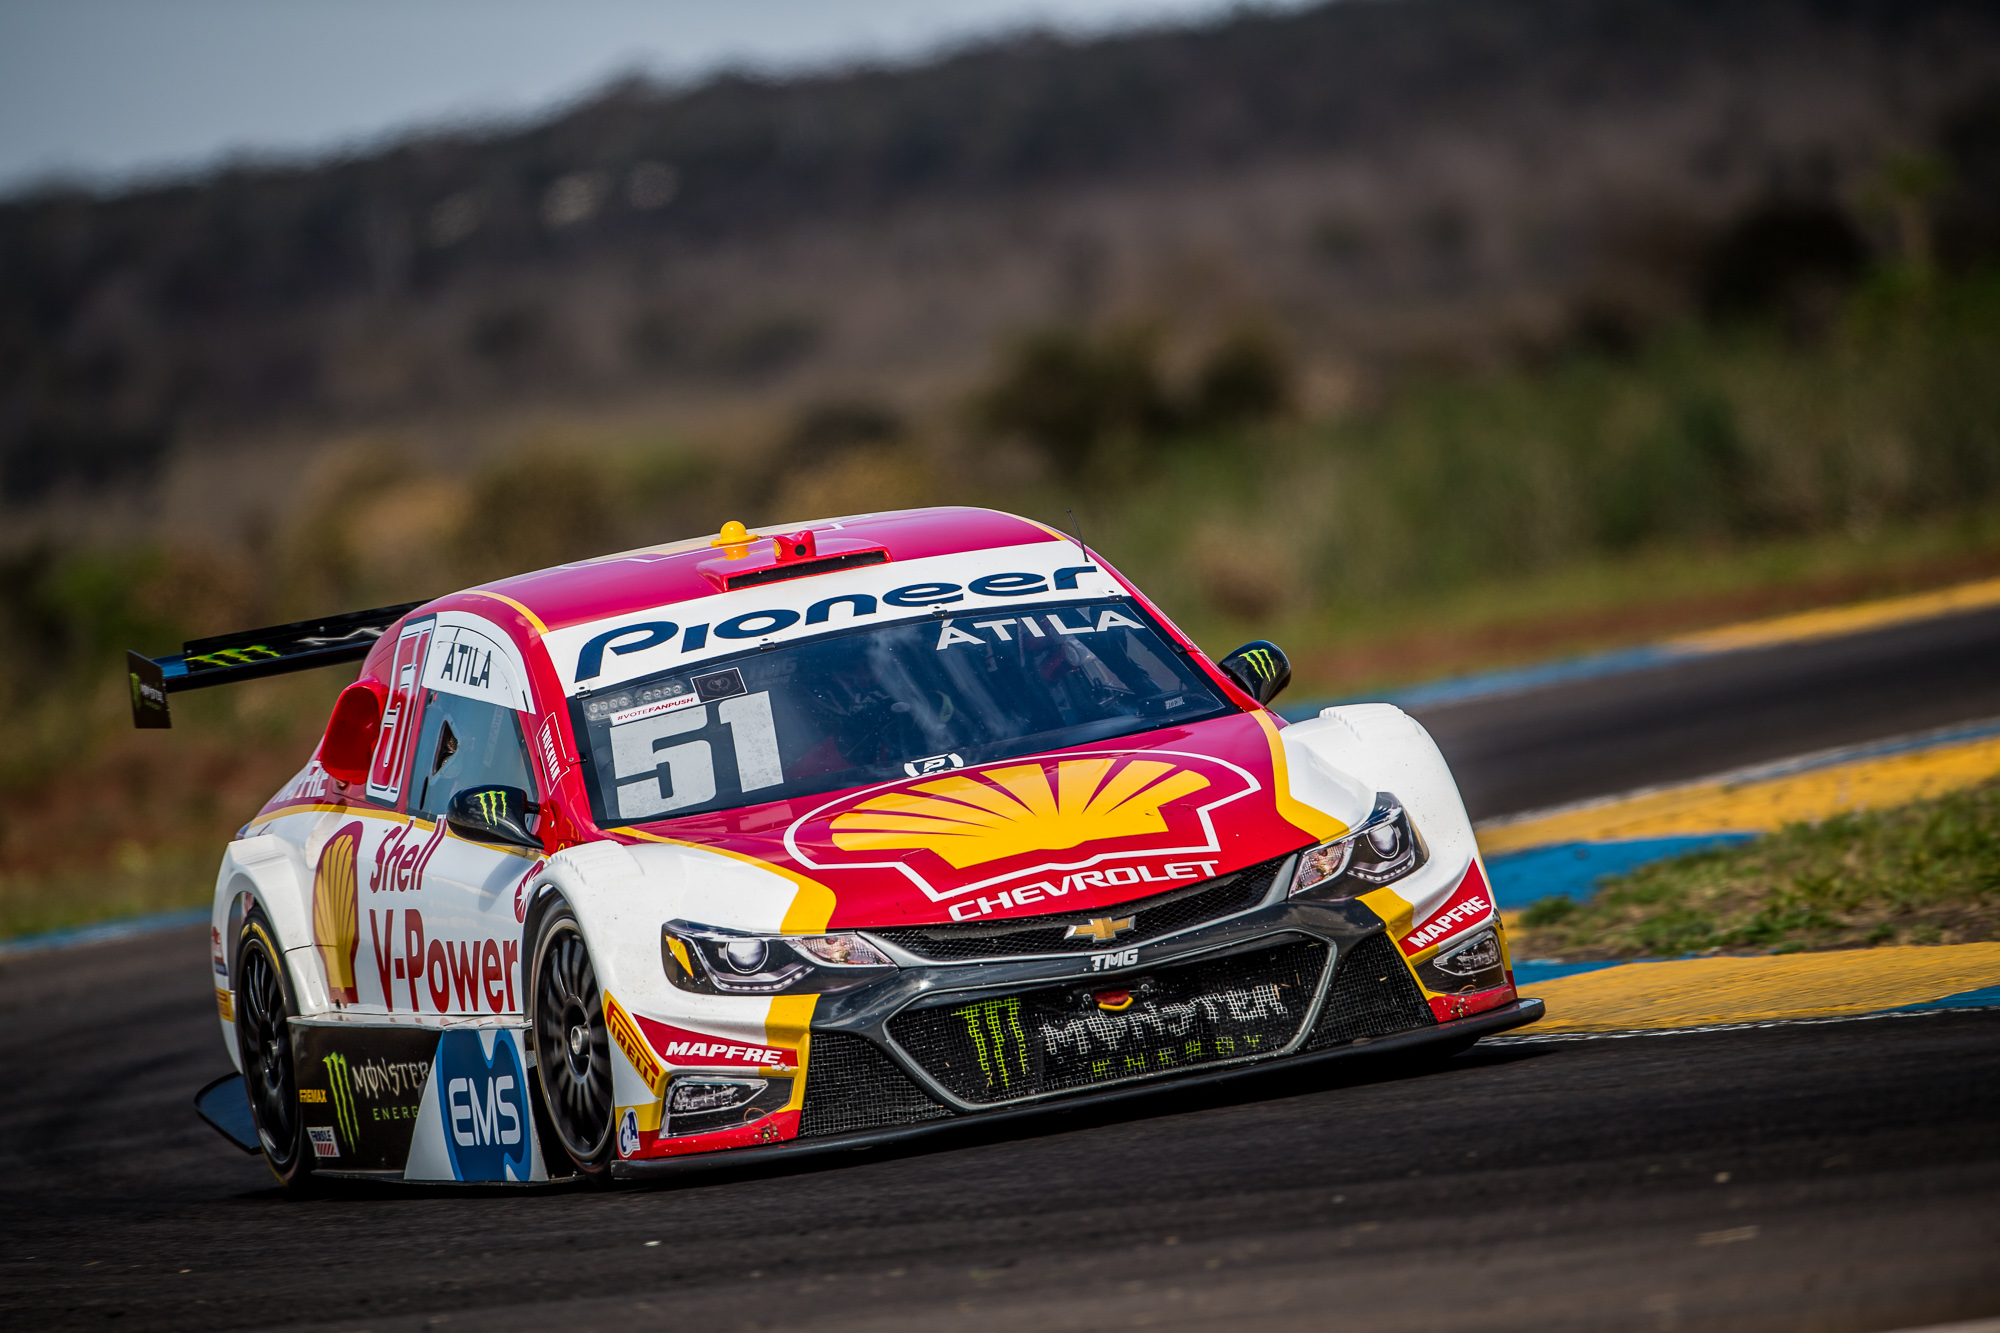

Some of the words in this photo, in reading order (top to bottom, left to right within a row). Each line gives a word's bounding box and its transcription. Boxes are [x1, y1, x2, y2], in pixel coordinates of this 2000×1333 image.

[574, 566, 1098, 684] Pioneer
[936, 610, 1146, 650] ÁTILA
[617, 697, 694, 720] #VOTEFANPUSH
[609, 690, 784, 819] 51
[369, 815, 448, 894] Shell
[949, 860, 1219, 922] CHEVROLET
[1407, 896, 1490, 948] MAPFRE
[369, 909, 518, 1014] V-Power
[1091, 948, 1138, 972] TMG
[606, 1000, 660, 1091] PIRELLI
[665, 1041, 783, 1065] MAPFRE
[373, 1105, 420, 1121] ENERG
[448, 1075, 521, 1147] EMS
